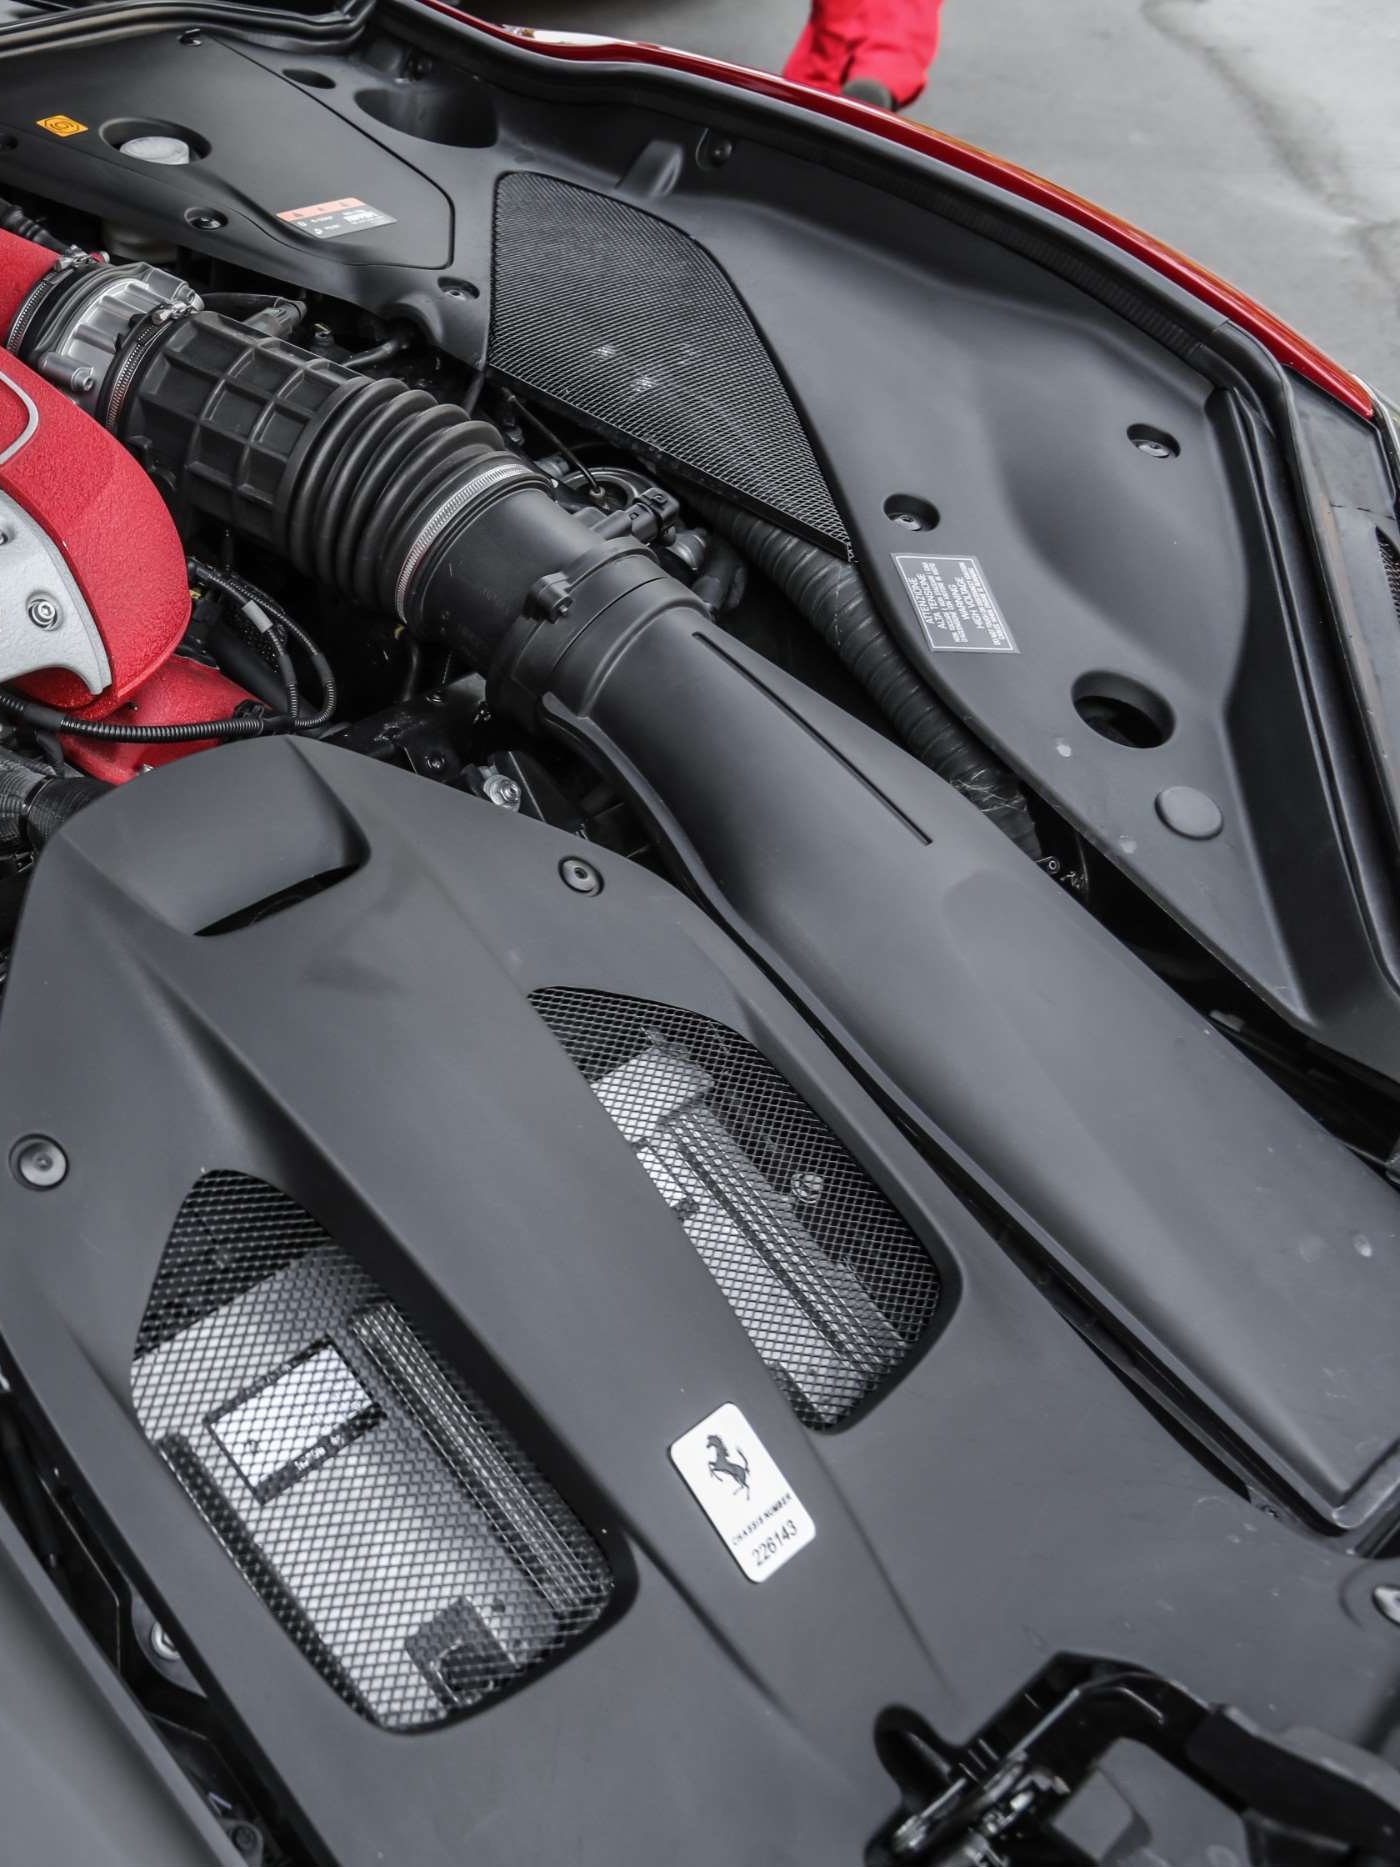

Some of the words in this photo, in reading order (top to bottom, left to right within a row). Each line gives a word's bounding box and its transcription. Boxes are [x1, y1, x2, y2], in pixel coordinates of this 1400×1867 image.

[908, 577, 935, 624] ATTENZIONE
[948, 584, 970, 620] WARNING
[732, 1516, 764, 1546] CHASSIS
[763, 1493, 792, 1518] NUMBER
[752, 1519, 798, 1567] 226143
